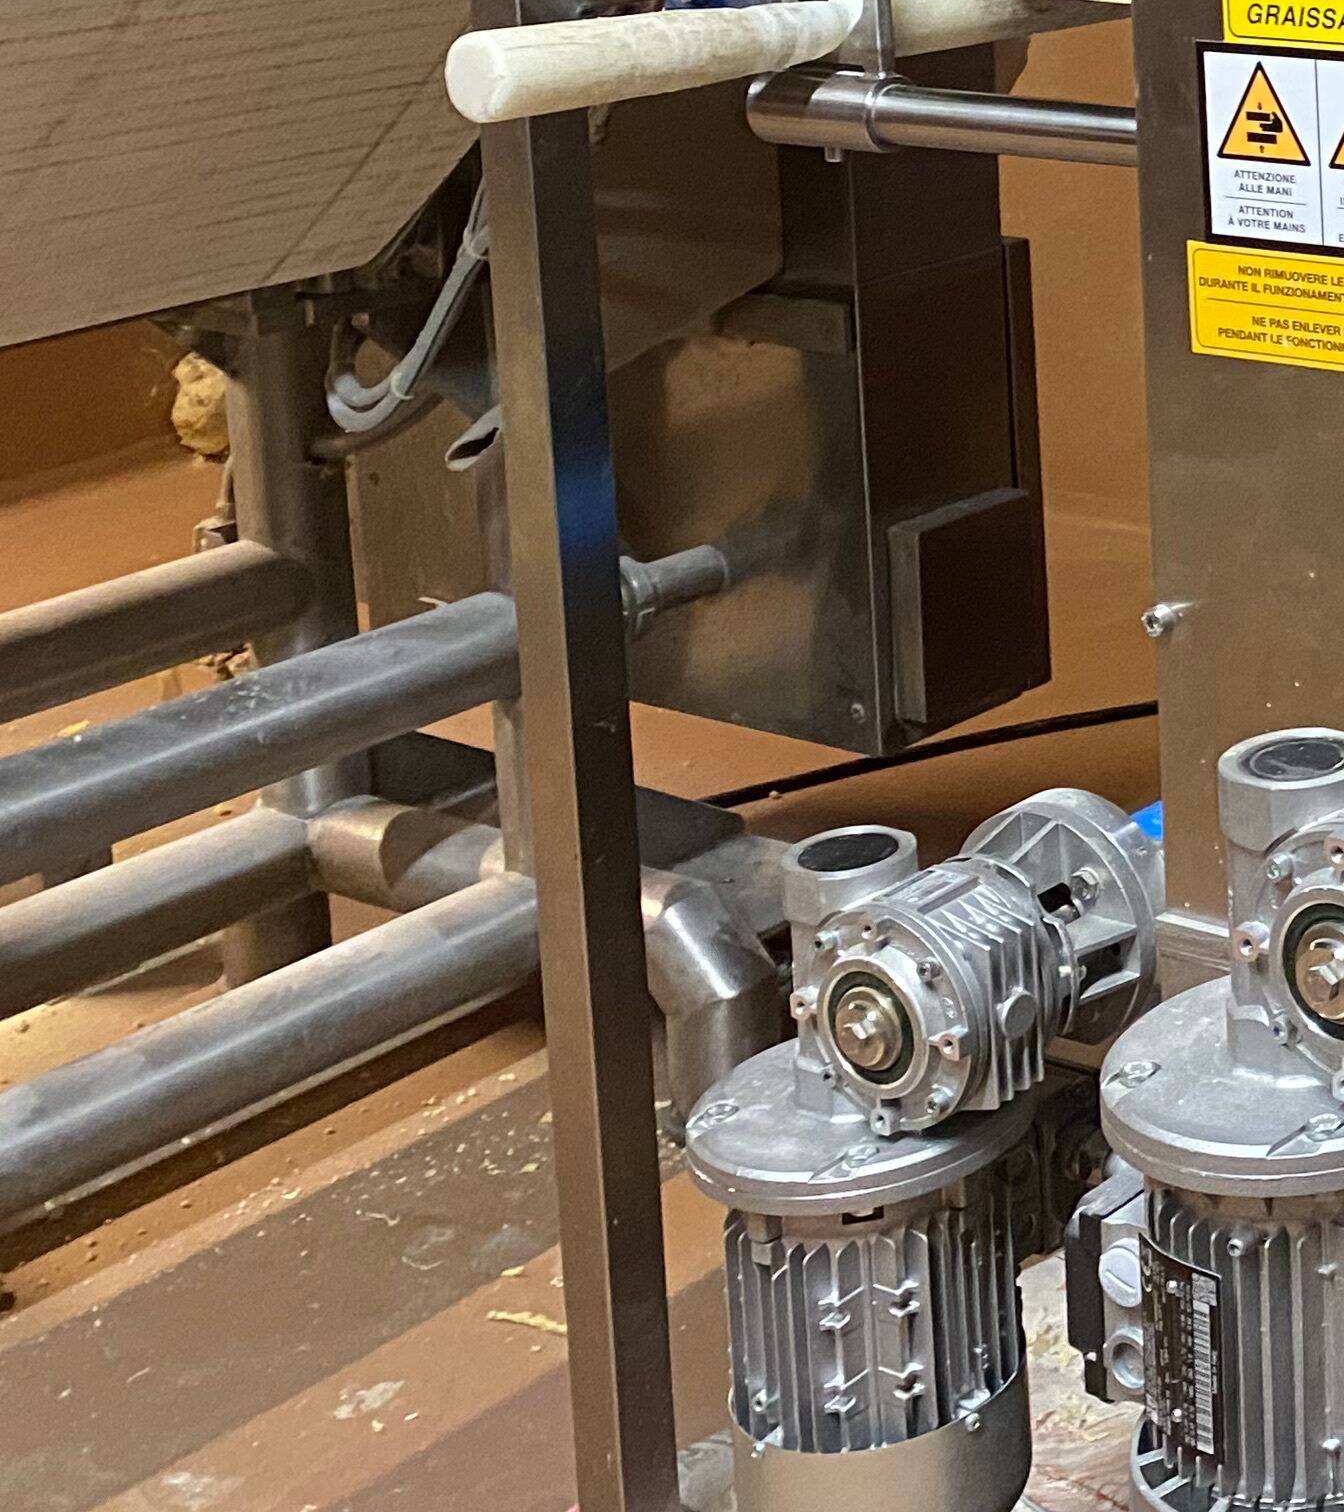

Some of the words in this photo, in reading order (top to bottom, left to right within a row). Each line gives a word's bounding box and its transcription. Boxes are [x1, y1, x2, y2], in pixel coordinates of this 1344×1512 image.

[1234, 170, 1296, 183] ATTENZIONE
[1239, 183, 1263, 194] ALLE
[1266, 186, 1292, 196] MANI
[1239, 205, 1294, 219] ATTENTION
[1237, 218, 1270, 229] VOTRE
[1273, 221, 1306, 233] MAINS
[1238, 266, 1261, 277] NON
[1264, 268, 1328, 285] RIMUOVERE
[1331, 276, 1344, 287] LE
[1199, 277, 1249, 292] DURANTE
[1251, 283, 1261, 293] IL
[1252, 316, 1267, 327] NE
[1269, 318, 1290, 329] PAS
[1292, 321, 1341, 336] ENLEVER
[1218, 328, 1268, 343] PENDANT
[1270, 335, 1282, 345] LE
